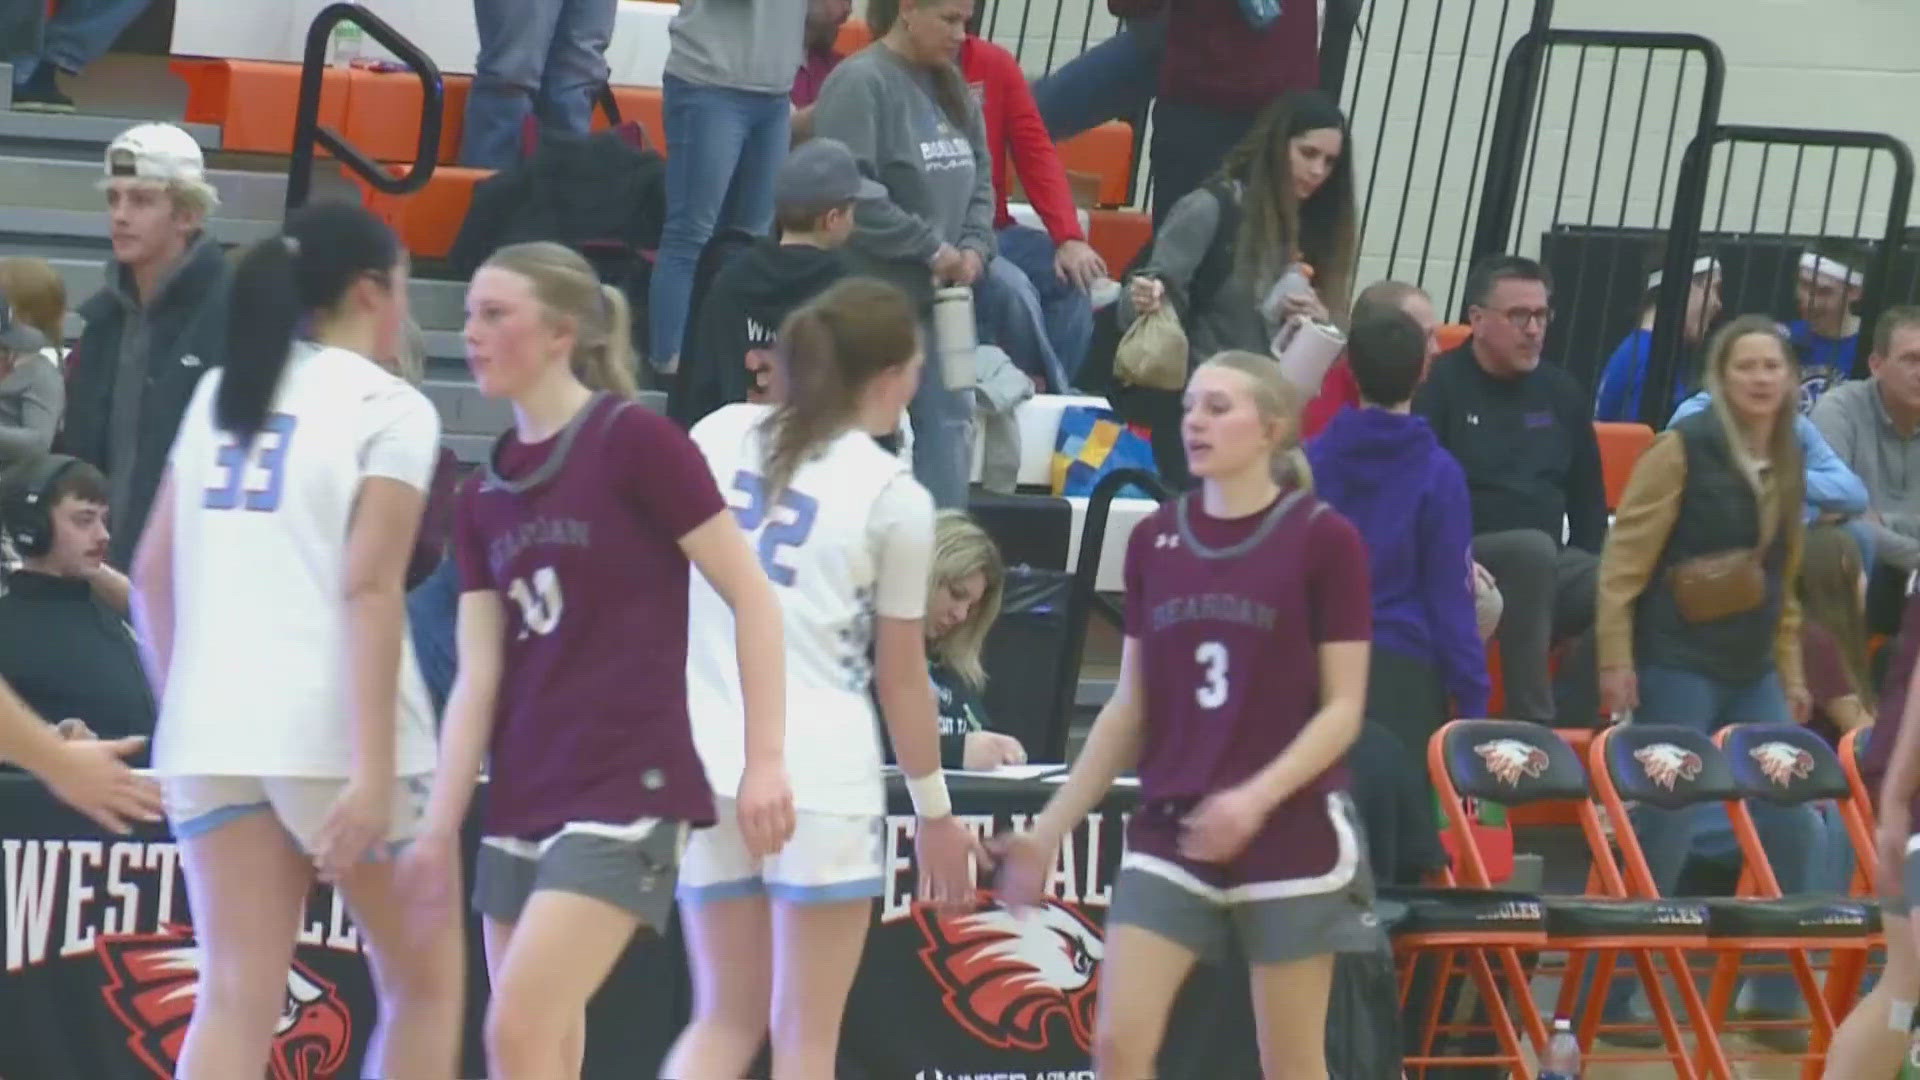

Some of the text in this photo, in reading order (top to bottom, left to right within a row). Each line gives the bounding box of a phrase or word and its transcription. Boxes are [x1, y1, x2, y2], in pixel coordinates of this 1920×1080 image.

[202, 411, 297, 513] 33
[1194, 641, 1230, 710] 3
[2, 838, 182, 972] WEST
